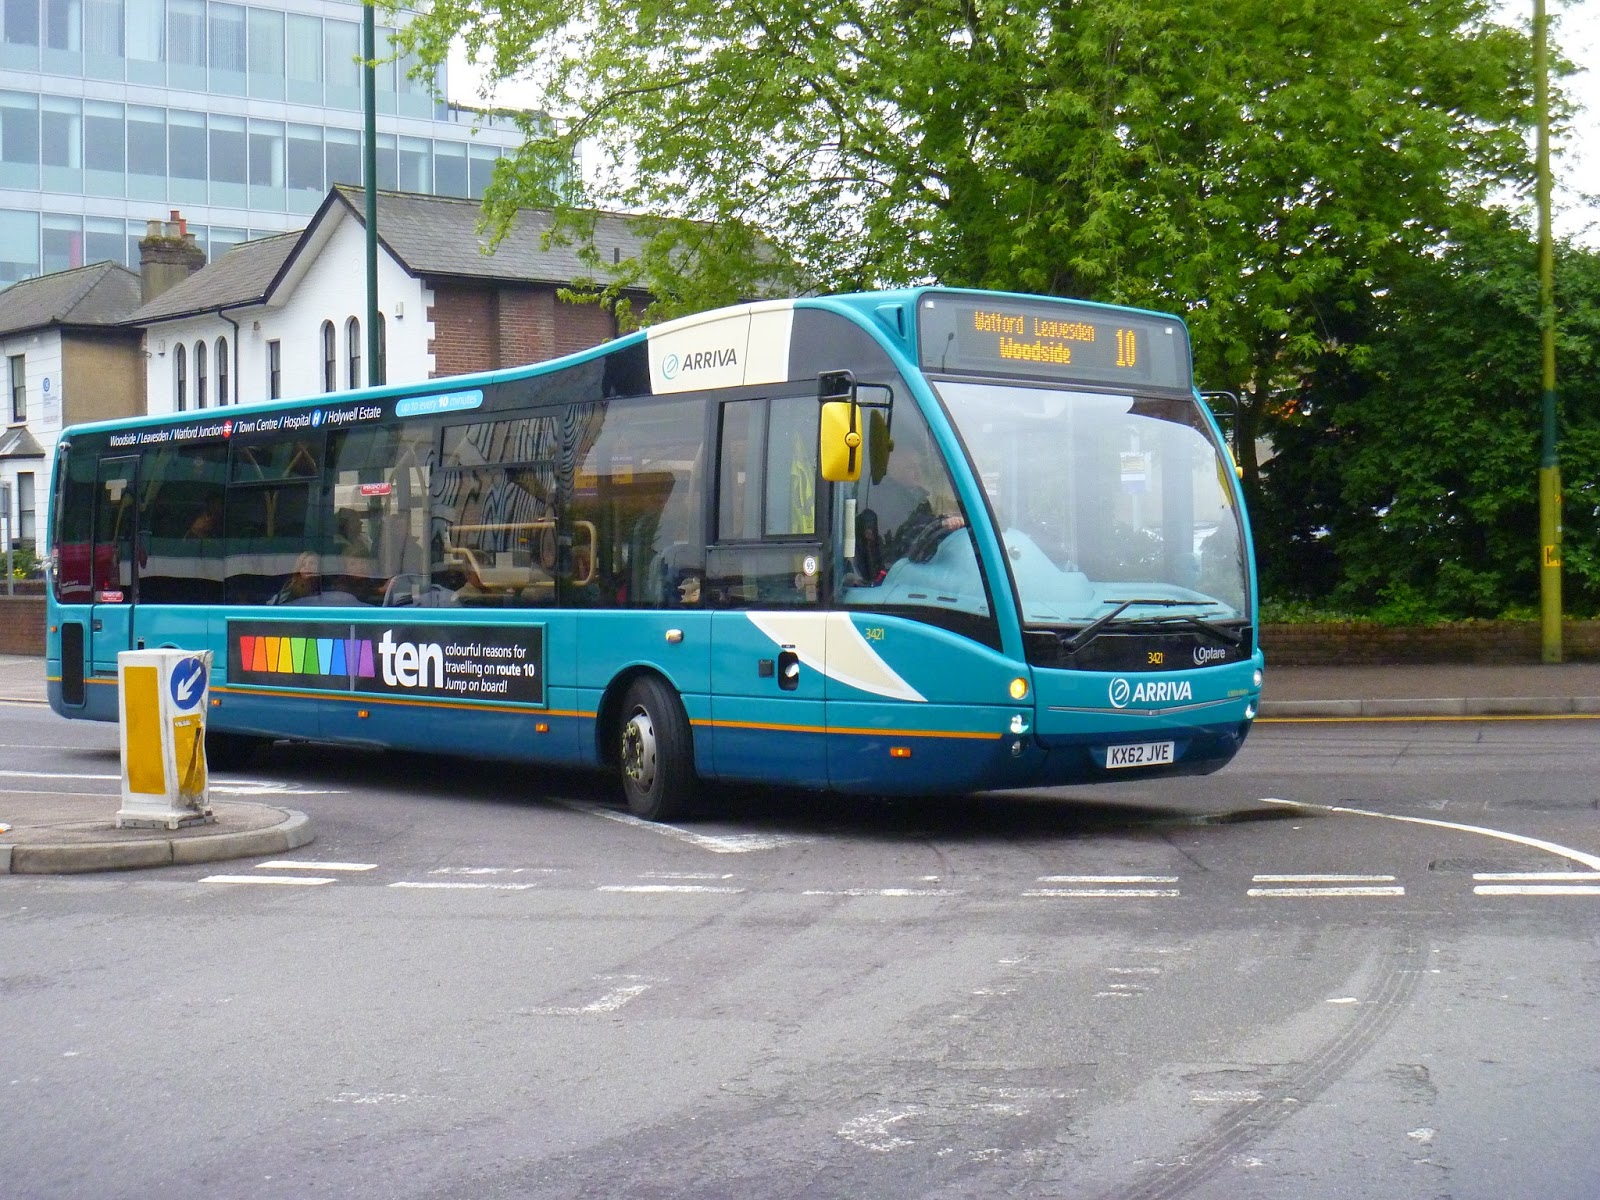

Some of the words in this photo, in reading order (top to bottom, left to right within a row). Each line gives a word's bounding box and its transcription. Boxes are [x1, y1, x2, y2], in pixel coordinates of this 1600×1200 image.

[974, 311, 1024, 334] Watford
[1034, 317, 1095, 342] Leavesden
[999, 337, 1071, 364] Woodside
[1115, 329, 1136, 367] 10
[682, 348, 737, 372] ARRIVA
[411, 402, 419, 411] to
[419, 400, 437, 410] every
[438, 396, 449, 407] 10
[449, 394, 477, 406] minutes
[110, 433, 136, 447] Woodside
[140, 430, 169, 443] Leavesden
[174, 426, 198, 440] Watford
[198, 424, 223, 437] Junction
[238, 421, 255, 433] Town
[256, 418, 278, 432] Centre
[283, 413, 311, 430] Hospital
[328, 406, 358, 426] Holywell
[359, 406, 381, 419] Estate
[806, 561, 814, 570] 95
[865, 628, 885, 640] 3421
[378, 629, 444, 689] ten
[445, 642, 481, 657] colourful
[482, 646, 512, 659] reasons
[513, 644, 527, 659] for
[1147, 652, 1163, 665] 3421
[1197, 646, 1226, 663] Optare
[445, 660, 483, 678] travelling
[484, 663, 496, 675] on
[496, 663, 522, 676] route
[522, 663, 535, 677] 10
[445, 678, 467, 694] Jump
[468, 681, 480, 692] on
[481, 678, 508, 693] board!
[1131, 681, 1193, 703] ARRIVA
[1111, 746, 1143, 765] KX62
[1146, 744, 1170, 762] JVE
